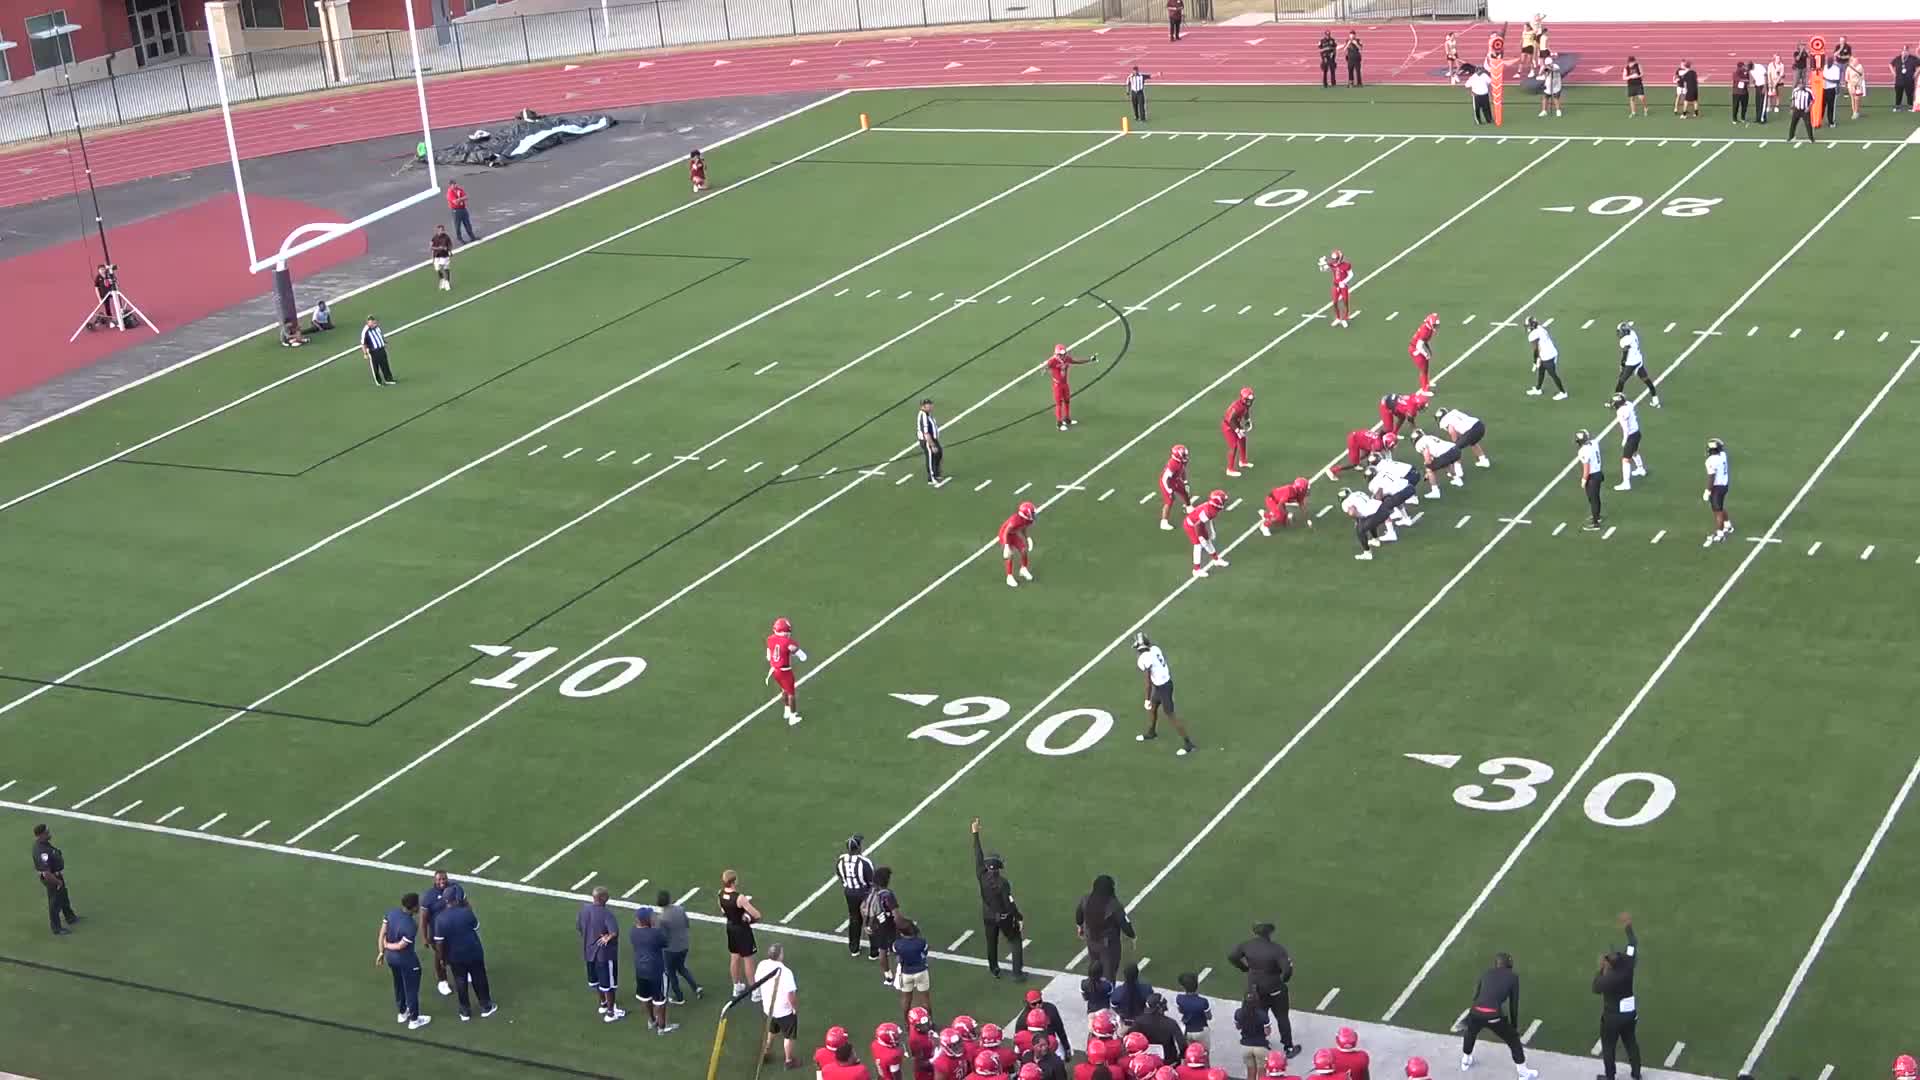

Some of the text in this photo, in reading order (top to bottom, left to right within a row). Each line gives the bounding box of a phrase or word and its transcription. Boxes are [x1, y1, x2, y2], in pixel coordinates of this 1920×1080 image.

[470, 646, 648, 698] 10
[907, 695, 1114, 756] 20
[1452, 757, 1677, 827] 30
